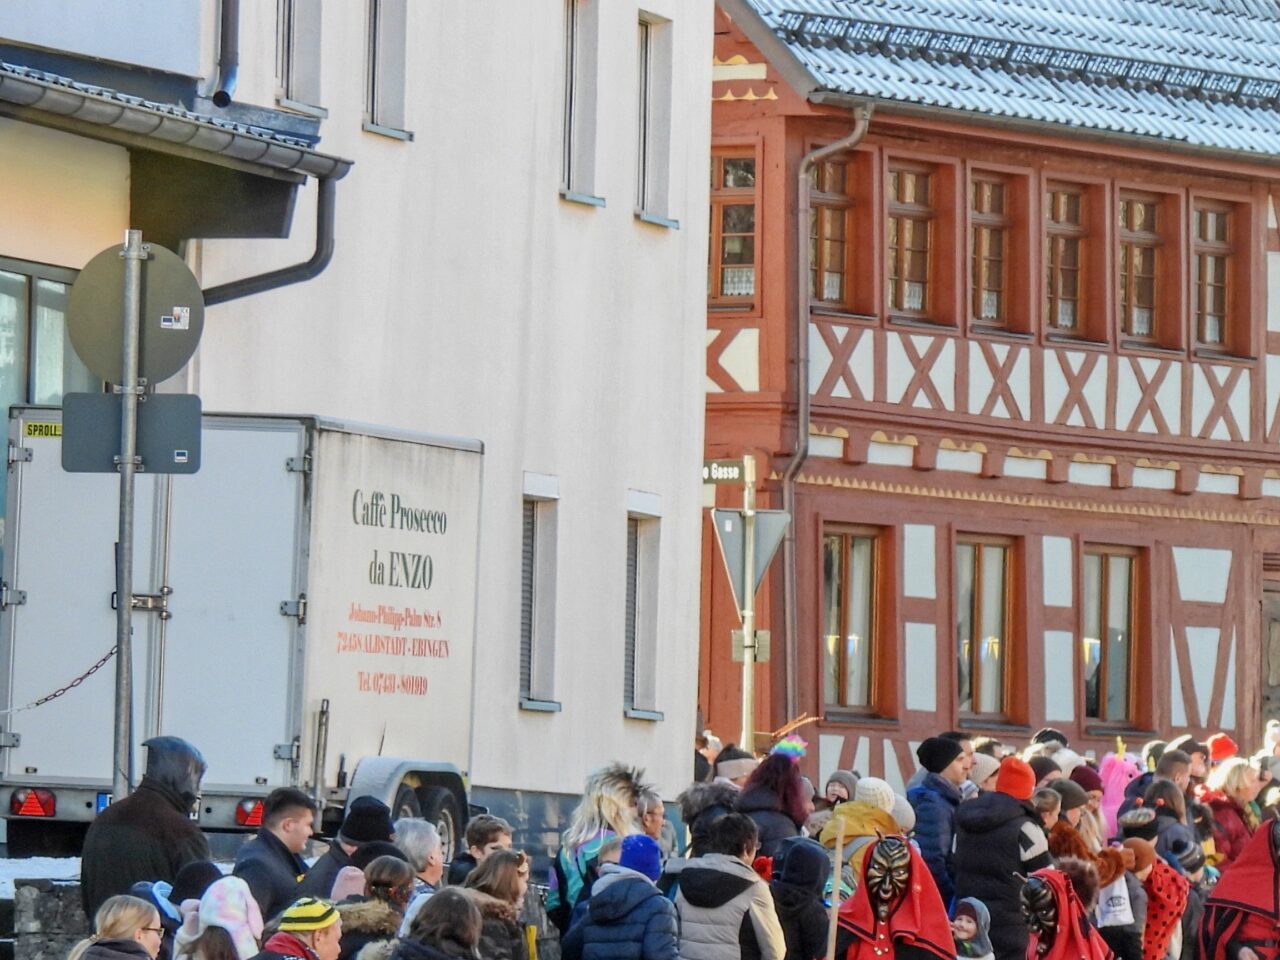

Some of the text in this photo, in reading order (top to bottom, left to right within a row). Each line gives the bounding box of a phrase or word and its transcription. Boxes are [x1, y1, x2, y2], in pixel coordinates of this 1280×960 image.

[711, 462, 739, 480] Gasse
[389, 493, 447, 535] Prosecco
[369, 549, 433, 590] da ENZO
